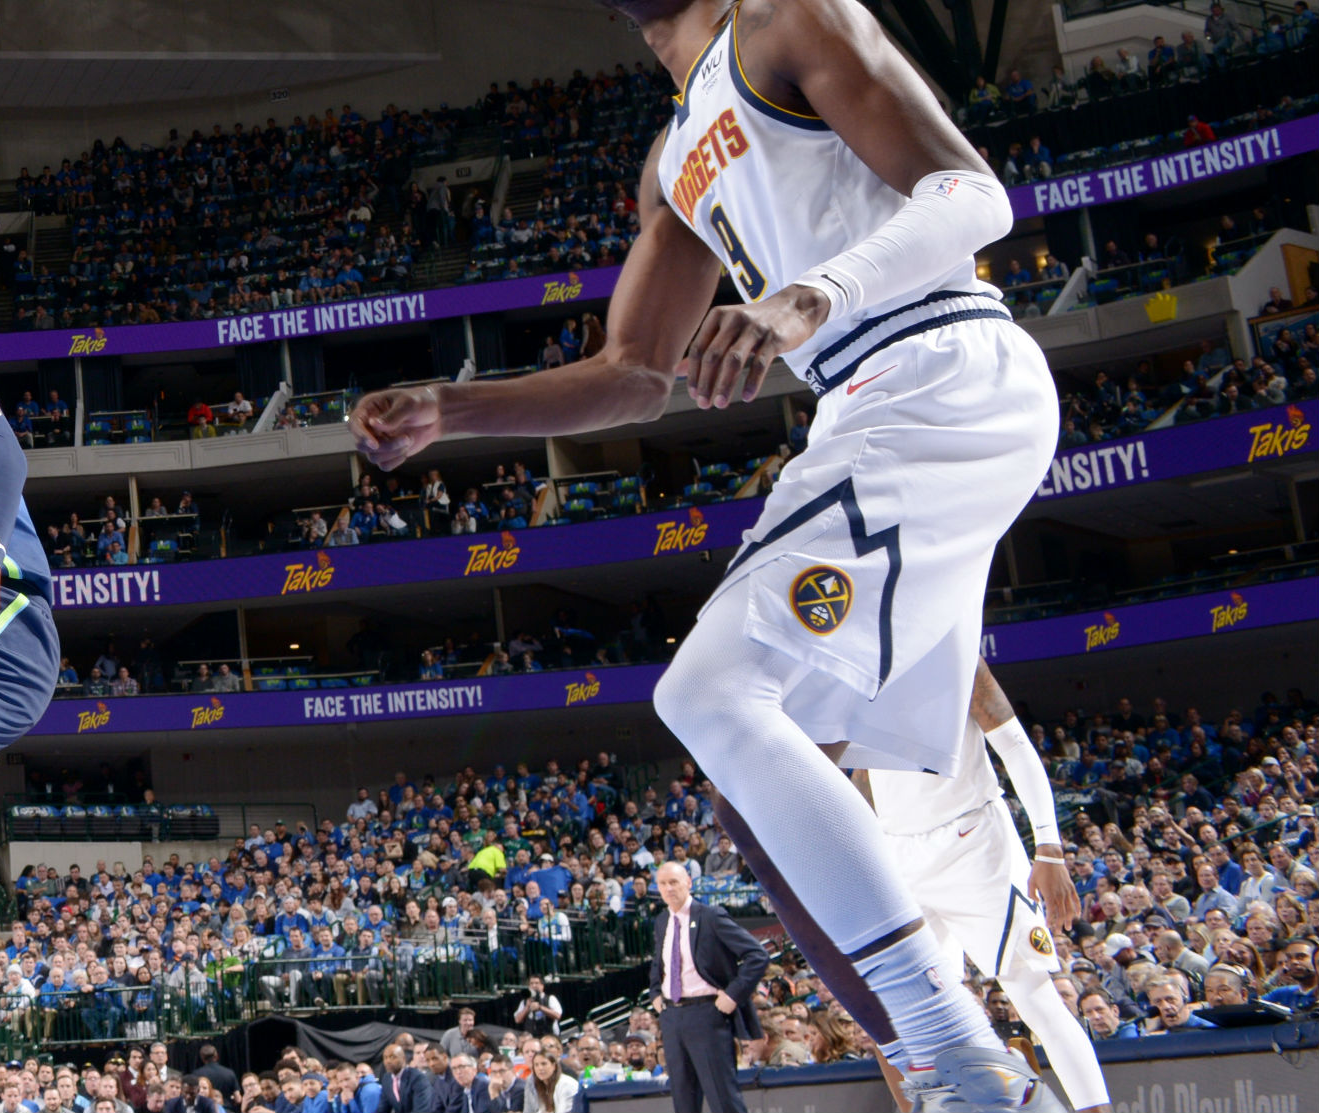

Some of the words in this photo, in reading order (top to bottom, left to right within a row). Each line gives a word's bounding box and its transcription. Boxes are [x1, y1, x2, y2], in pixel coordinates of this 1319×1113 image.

[1034, 177, 1095, 213] FACE
[1098, 164, 1147, 199] THE
[1154, 128, 1283, 185] INTENSITY!
[710, 202, 768, 302] 9
[541, 282, 582, 306] Takis
[218, 316, 265, 345] FACE
[270, 310, 310, 338] THE
[314, 295, 426, 333] INTENSITY!
[68, 334, 108, 356] Takis
[1247, 419, 1312, 463] Takis
[653, 520, 709, 556] Takis
[281, 563, 334, 596] Takis
[1210, 602, 1248, 634] Takis
[304, 695, 346, 718] FACE
[349, 693, 383, 715] THE
[387, 685, 483, 713] INTENSITY!
[565, 682, 600, 707] Takis
[191, 705, 224, 729] Takis
